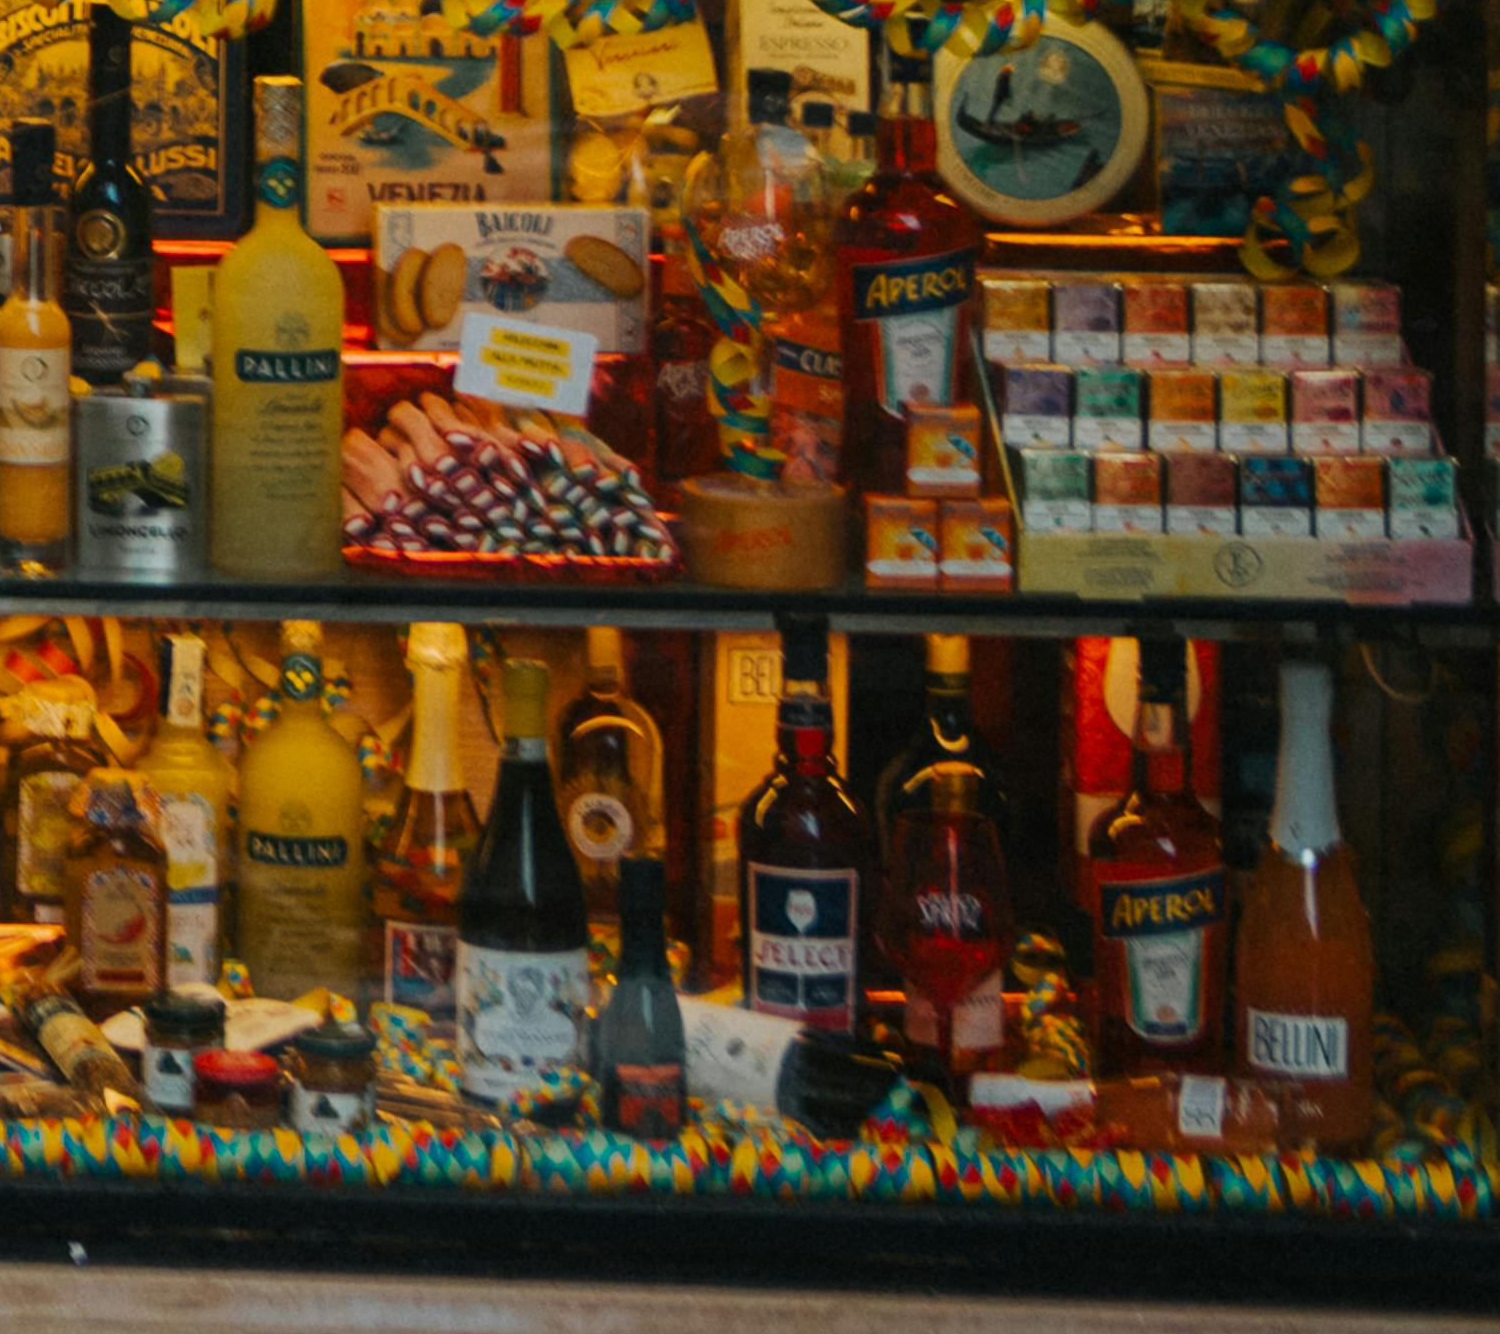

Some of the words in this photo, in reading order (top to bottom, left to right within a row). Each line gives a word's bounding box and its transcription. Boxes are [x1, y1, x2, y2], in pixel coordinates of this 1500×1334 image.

[367, 182, 487, 203] VENEZIA
[243, 352, 335, 379] PALLINI
[249, 836, 348, 862] PALLINI
[1111, 888, 1216, 928] APEROL
[755, 935, 852, 970] SELECT
[1253, 1015, 1341, 1067] BELLINI
